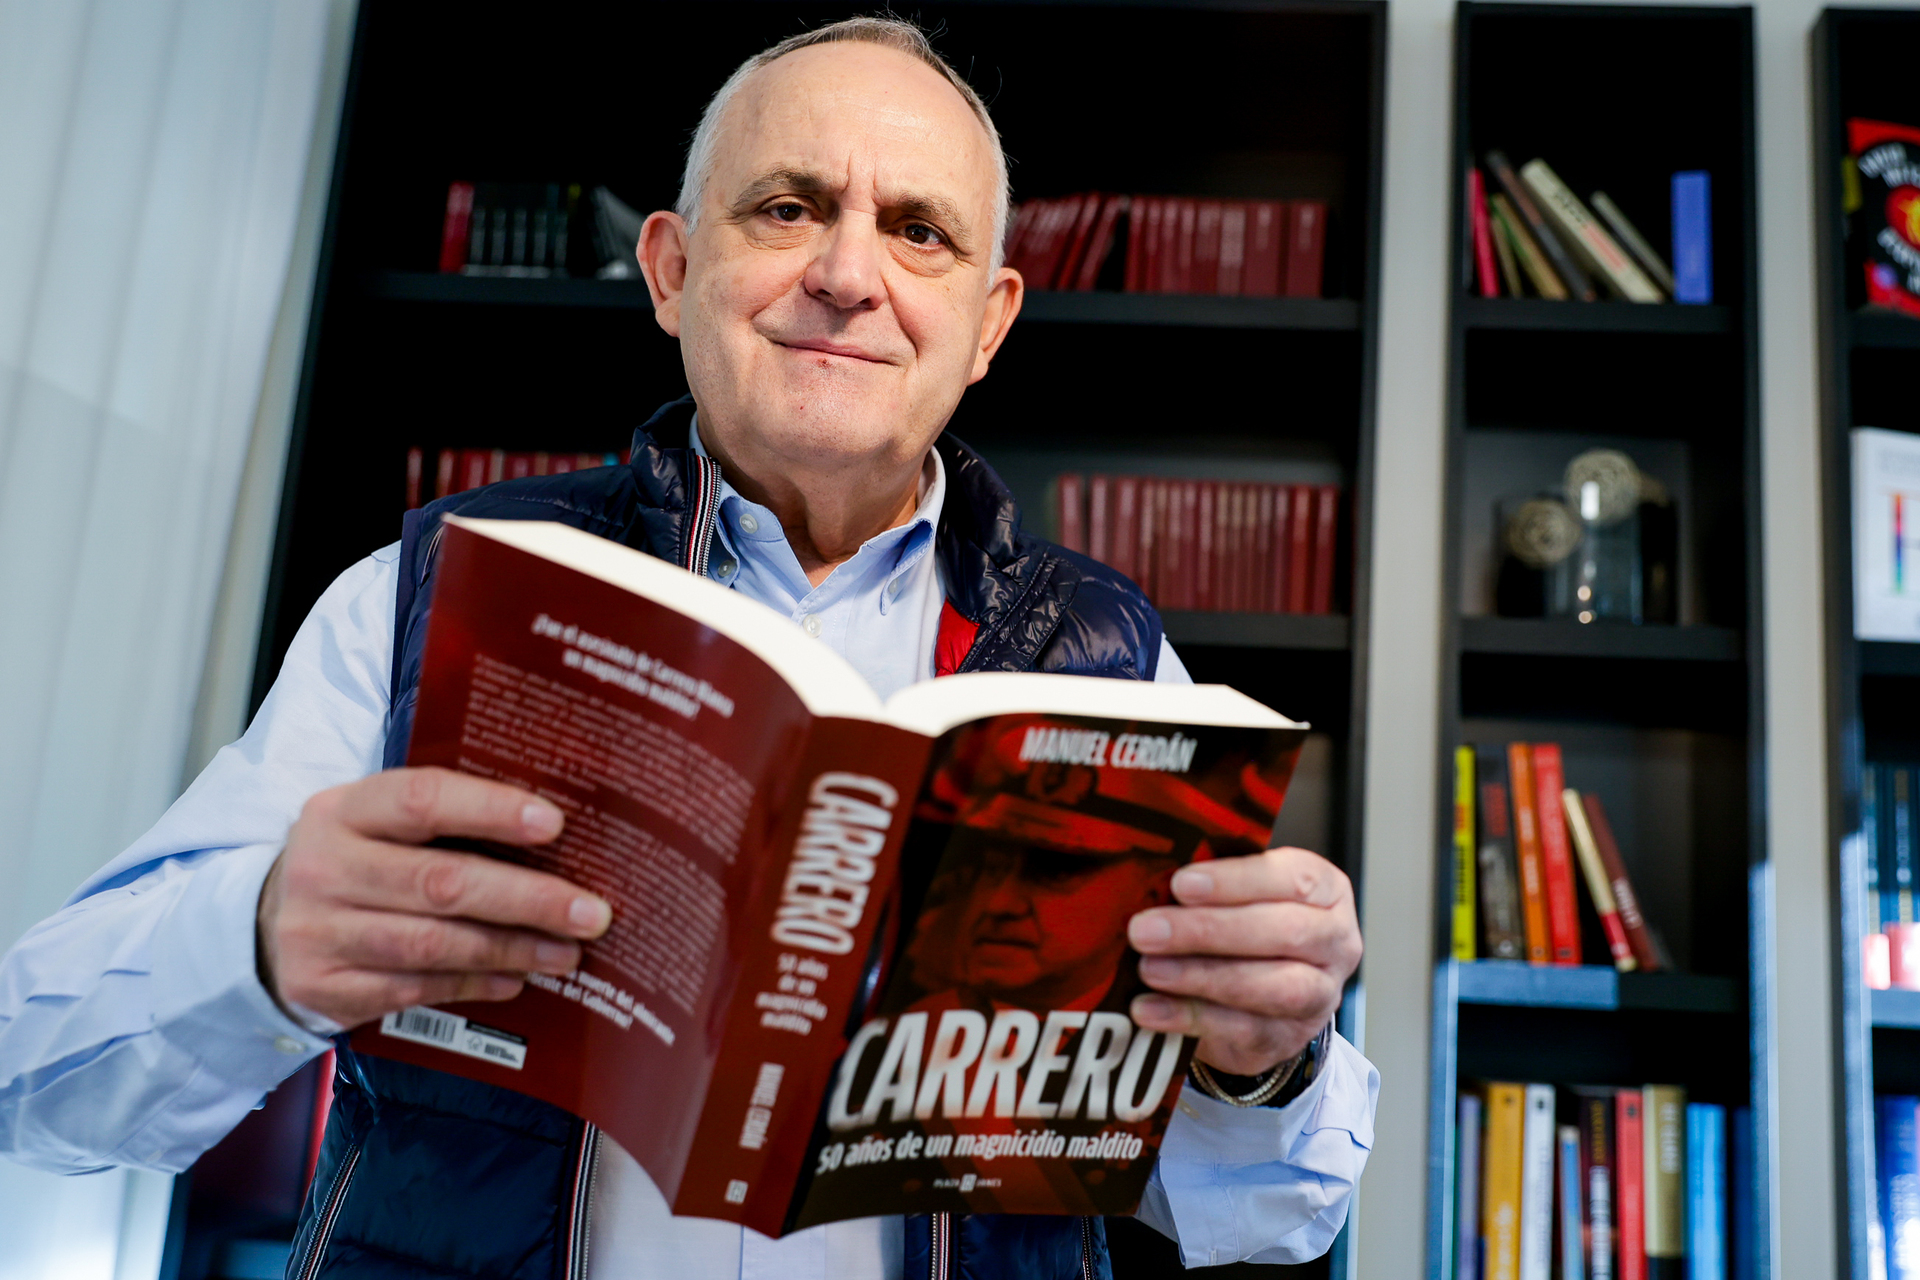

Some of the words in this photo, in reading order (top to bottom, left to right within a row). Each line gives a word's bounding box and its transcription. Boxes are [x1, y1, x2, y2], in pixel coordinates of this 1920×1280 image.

[1018, 726, 1110, 767] MANUEL
[1110, 731, 1198, 773] CERDÁN
[770, 771, 899, 956] CARRERO
[754, 991, 828, 1022] magnicidio
[760, 1011, 812, 1036] maldito
[827, 1008, 1184, 1131] CARRERO
[815, 1144, 845, 1175] 50
[844, 1135, 893, 1168] años
[894, 1130, 923, 1160] de
[923, 1133, 952, 1157] un
[952, 1129, 1064, 1161] magnicidio
[1064, 1131, 1143, 1160] maldito
